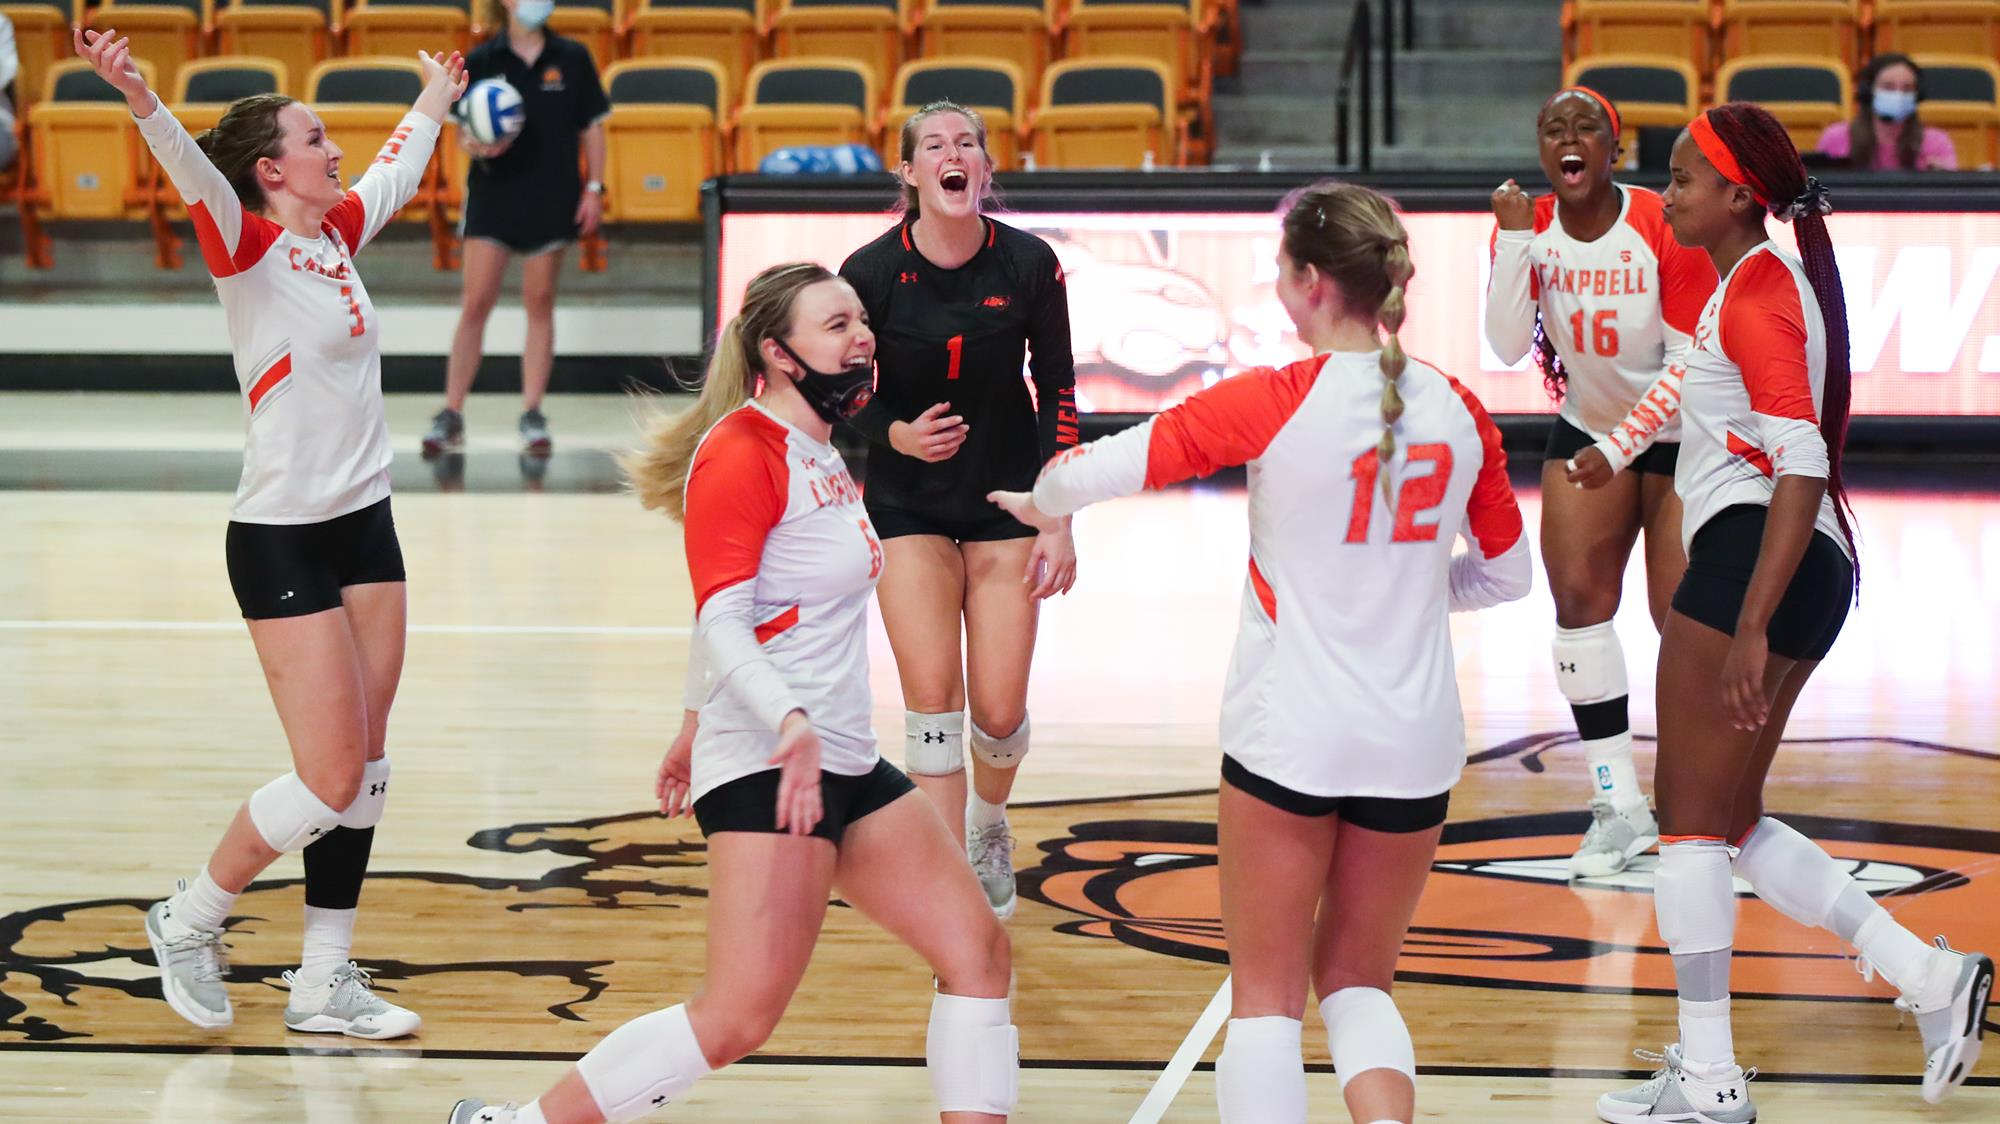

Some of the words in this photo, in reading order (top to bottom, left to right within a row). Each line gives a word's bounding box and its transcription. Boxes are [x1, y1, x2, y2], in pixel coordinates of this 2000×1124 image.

[946, 334, 964, 380] 1
[1569, 308, 1620, 358] 16
[1343, 441, 1455, 545] 12
